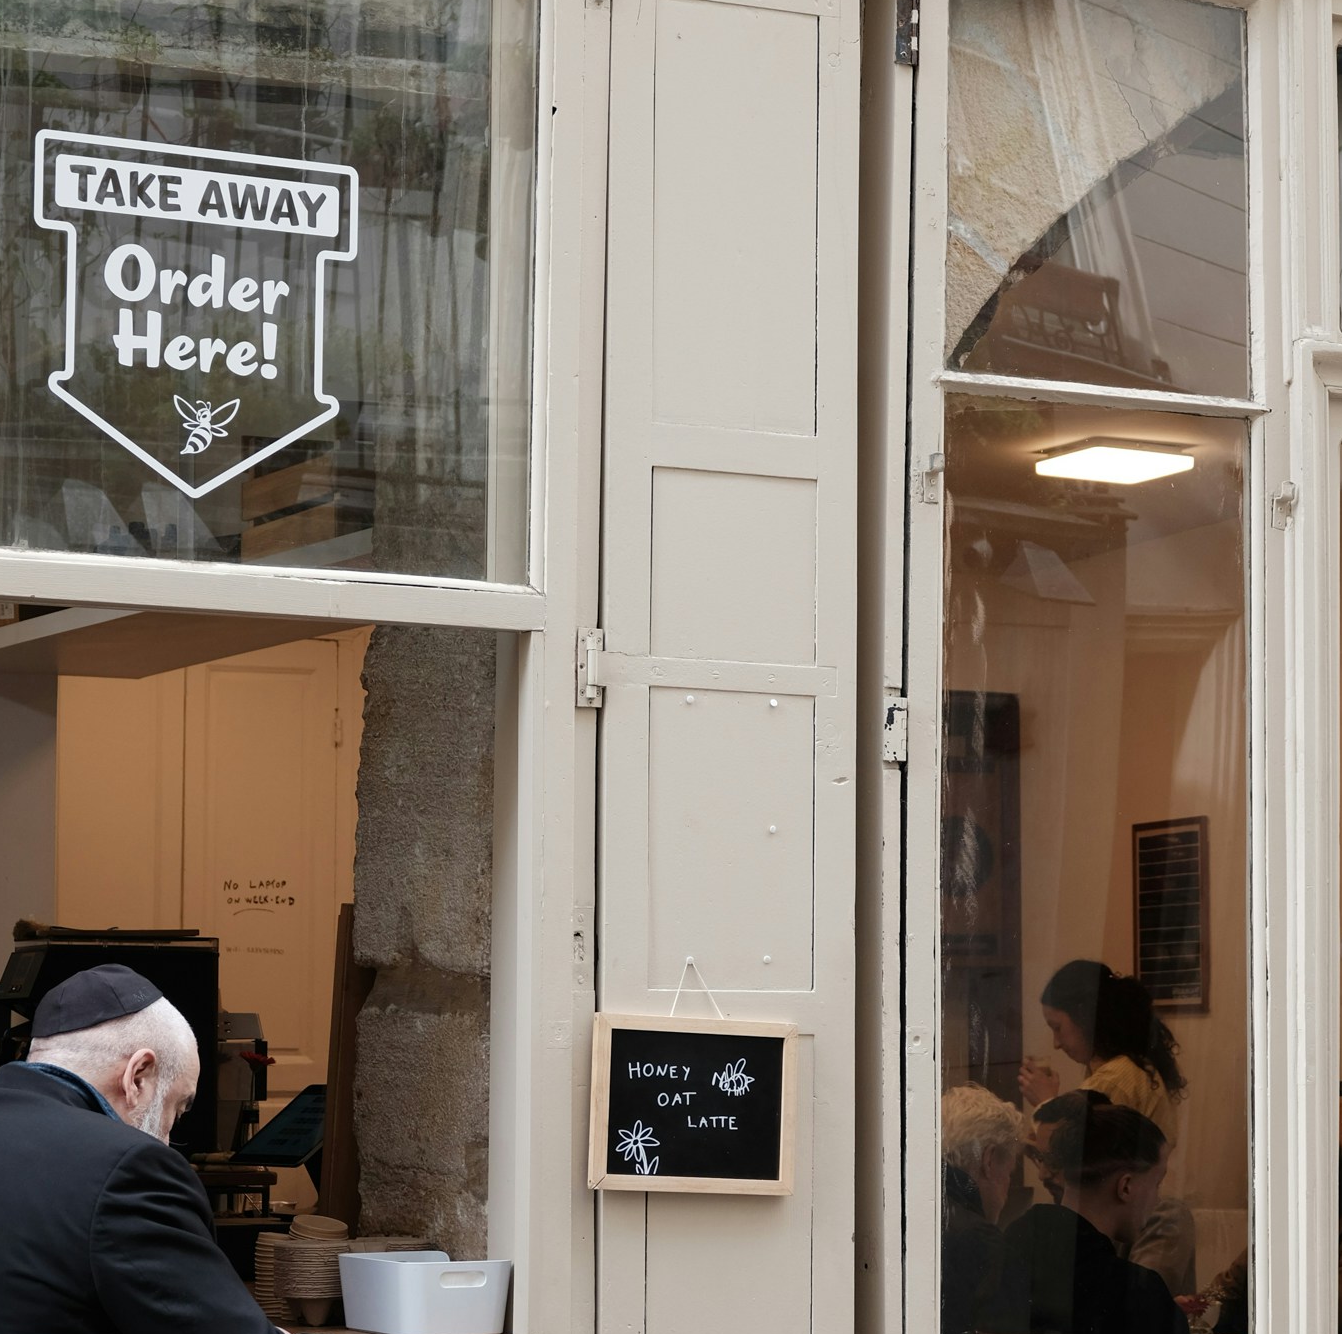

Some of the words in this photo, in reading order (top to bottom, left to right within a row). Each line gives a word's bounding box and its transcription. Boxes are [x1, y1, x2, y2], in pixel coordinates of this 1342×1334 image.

[69, 164, 182, 212] TAKE
[197, 179, 327, 228] AWAY
[104, 243, 290, 315] Order
[112, 308, 278, 380] Here!
[628, 1061, 690, 1081] HONEY
[657, 1092, 697, 1107] OAT
[687, 1116, 738, 1130] LATTE
